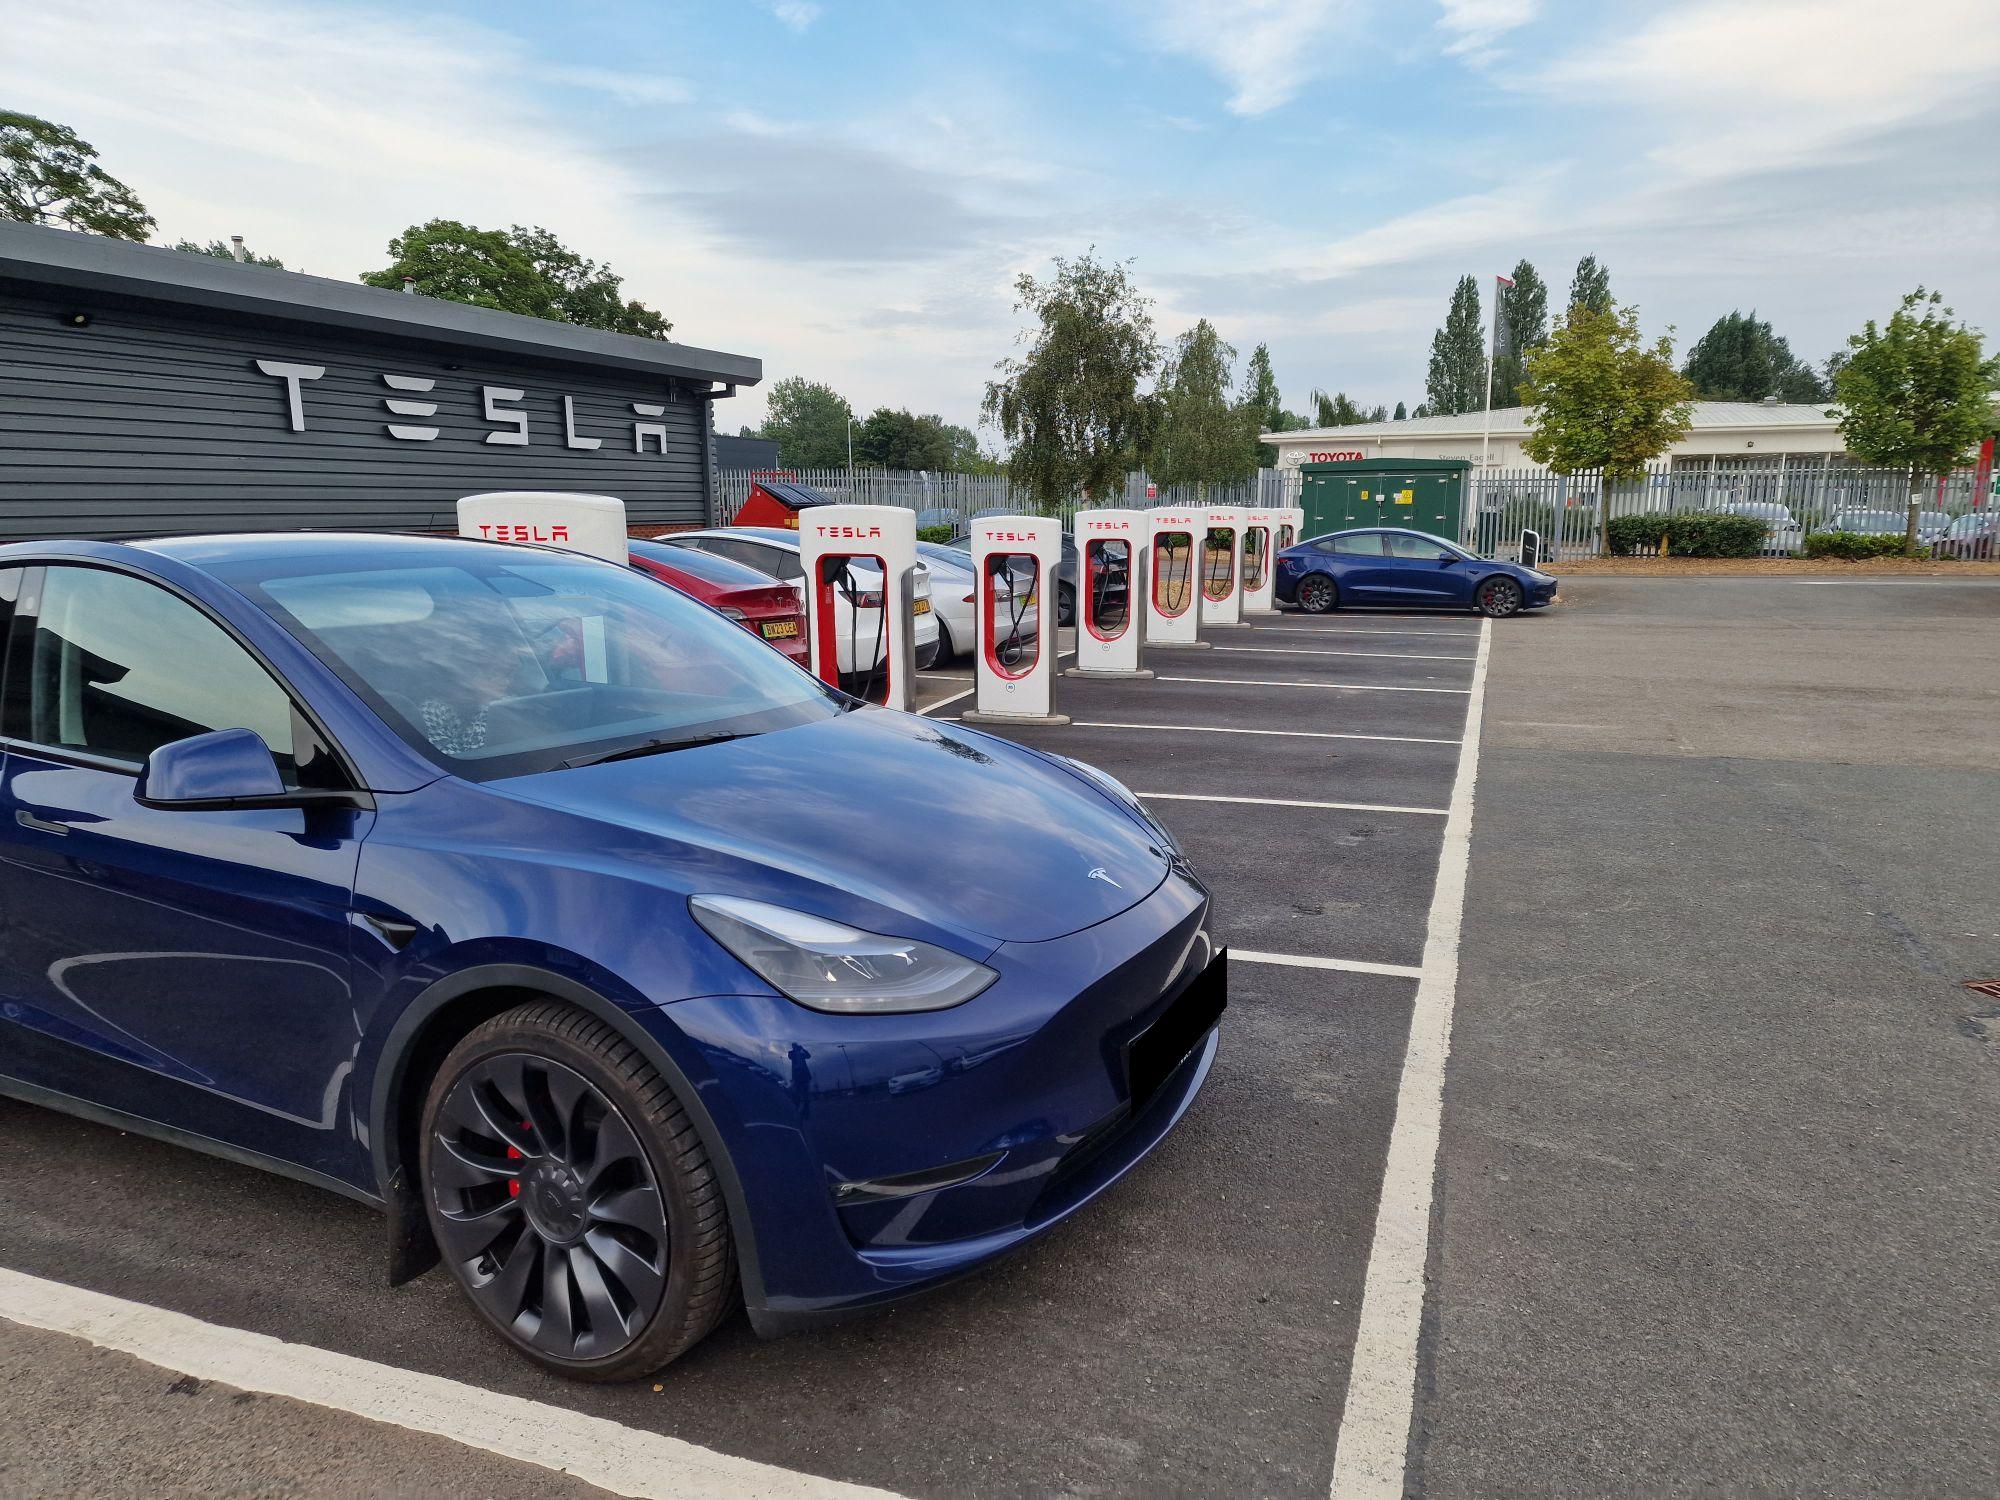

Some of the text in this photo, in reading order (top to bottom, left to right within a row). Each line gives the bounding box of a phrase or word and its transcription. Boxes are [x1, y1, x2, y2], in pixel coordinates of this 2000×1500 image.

[255, 359, 668, 454] TESLA
[1309, 452, 1364, 463] TOYOTA
[1087, 522, 1129, 530] TESLA
[478, 525, 568, 542] TESLA
[816, 526, 881, 539] TESLA
[985, 532, 1036, 542] TESLA
